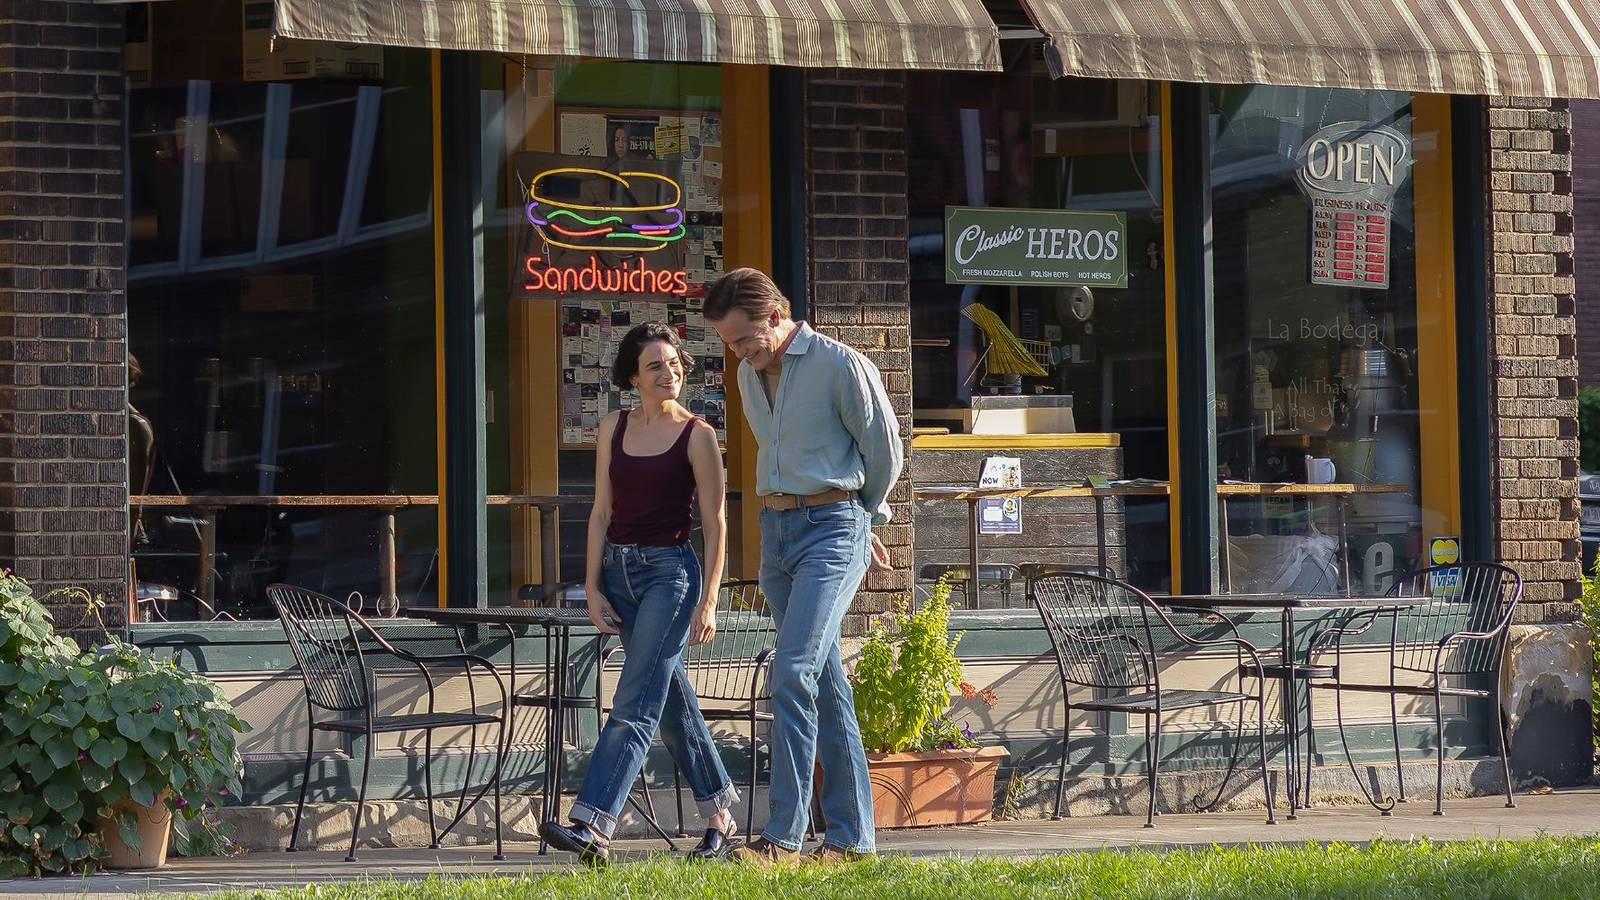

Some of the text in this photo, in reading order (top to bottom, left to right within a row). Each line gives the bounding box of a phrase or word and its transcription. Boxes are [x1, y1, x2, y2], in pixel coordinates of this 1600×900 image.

[1308, 138, 1394, 186] OPEN
[1314, 198, 1387, 212] BUSINESS HOURS
[954, 225, 1119, 265] Classic HEROS
[525, 255, 688, 294] Sandwiches
[962, 268, 1022, 278] FRESH MOZZARELLA
[1030, 270, 1069, 279] POLISH BOYS
[1078, 271, 1111, 280] HOT HEROS
[1267, 316, 1379, 347] La Bodega
[1286, 376, 1347, 395] All That
[1264, 496, 1290, 504] VEGAN
